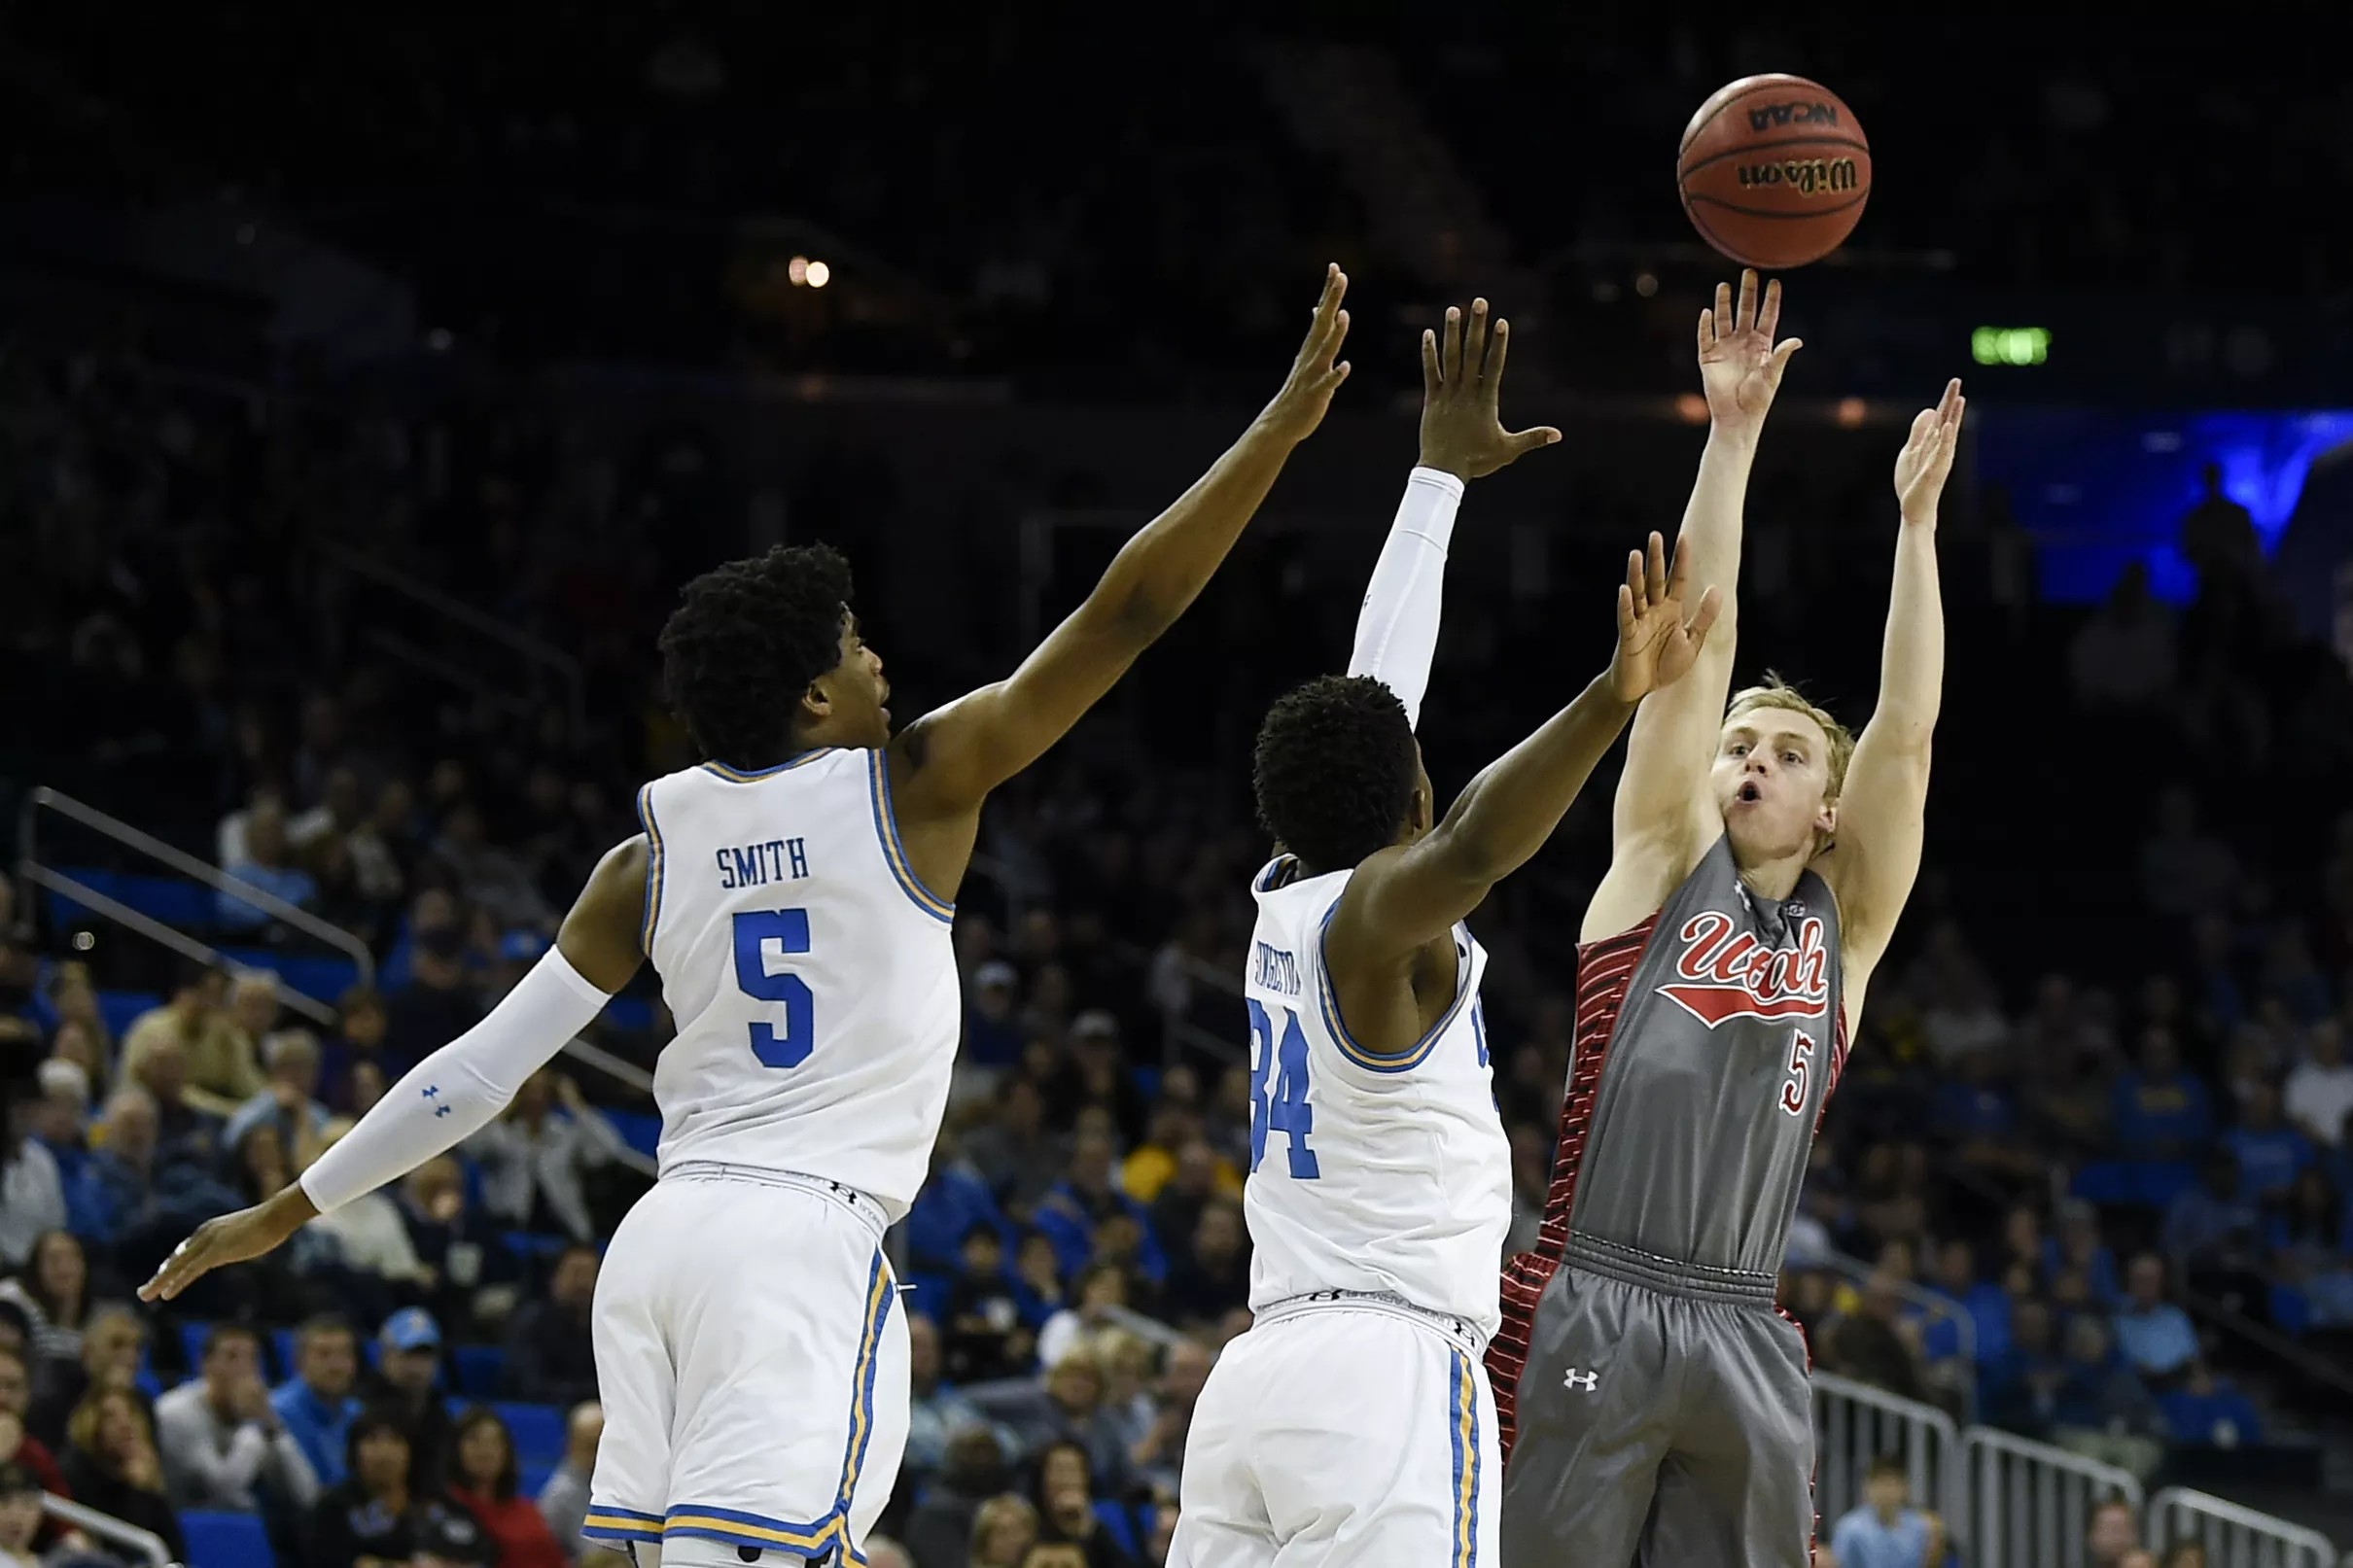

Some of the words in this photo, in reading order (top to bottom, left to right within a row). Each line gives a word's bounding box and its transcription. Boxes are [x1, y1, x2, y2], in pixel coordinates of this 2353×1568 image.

[1748, 100, 1837, 131] NCAA
[1737, 158, 1858, 197] Wilson
[716, 837, 810, 889] SMITH
[732, 908, 814, 1068] 5
[1676, 911, 1829, 1002] Utah
[1246, 997, 1320, 1179] 34
[1778, 1028, 1815, 1116] 5
